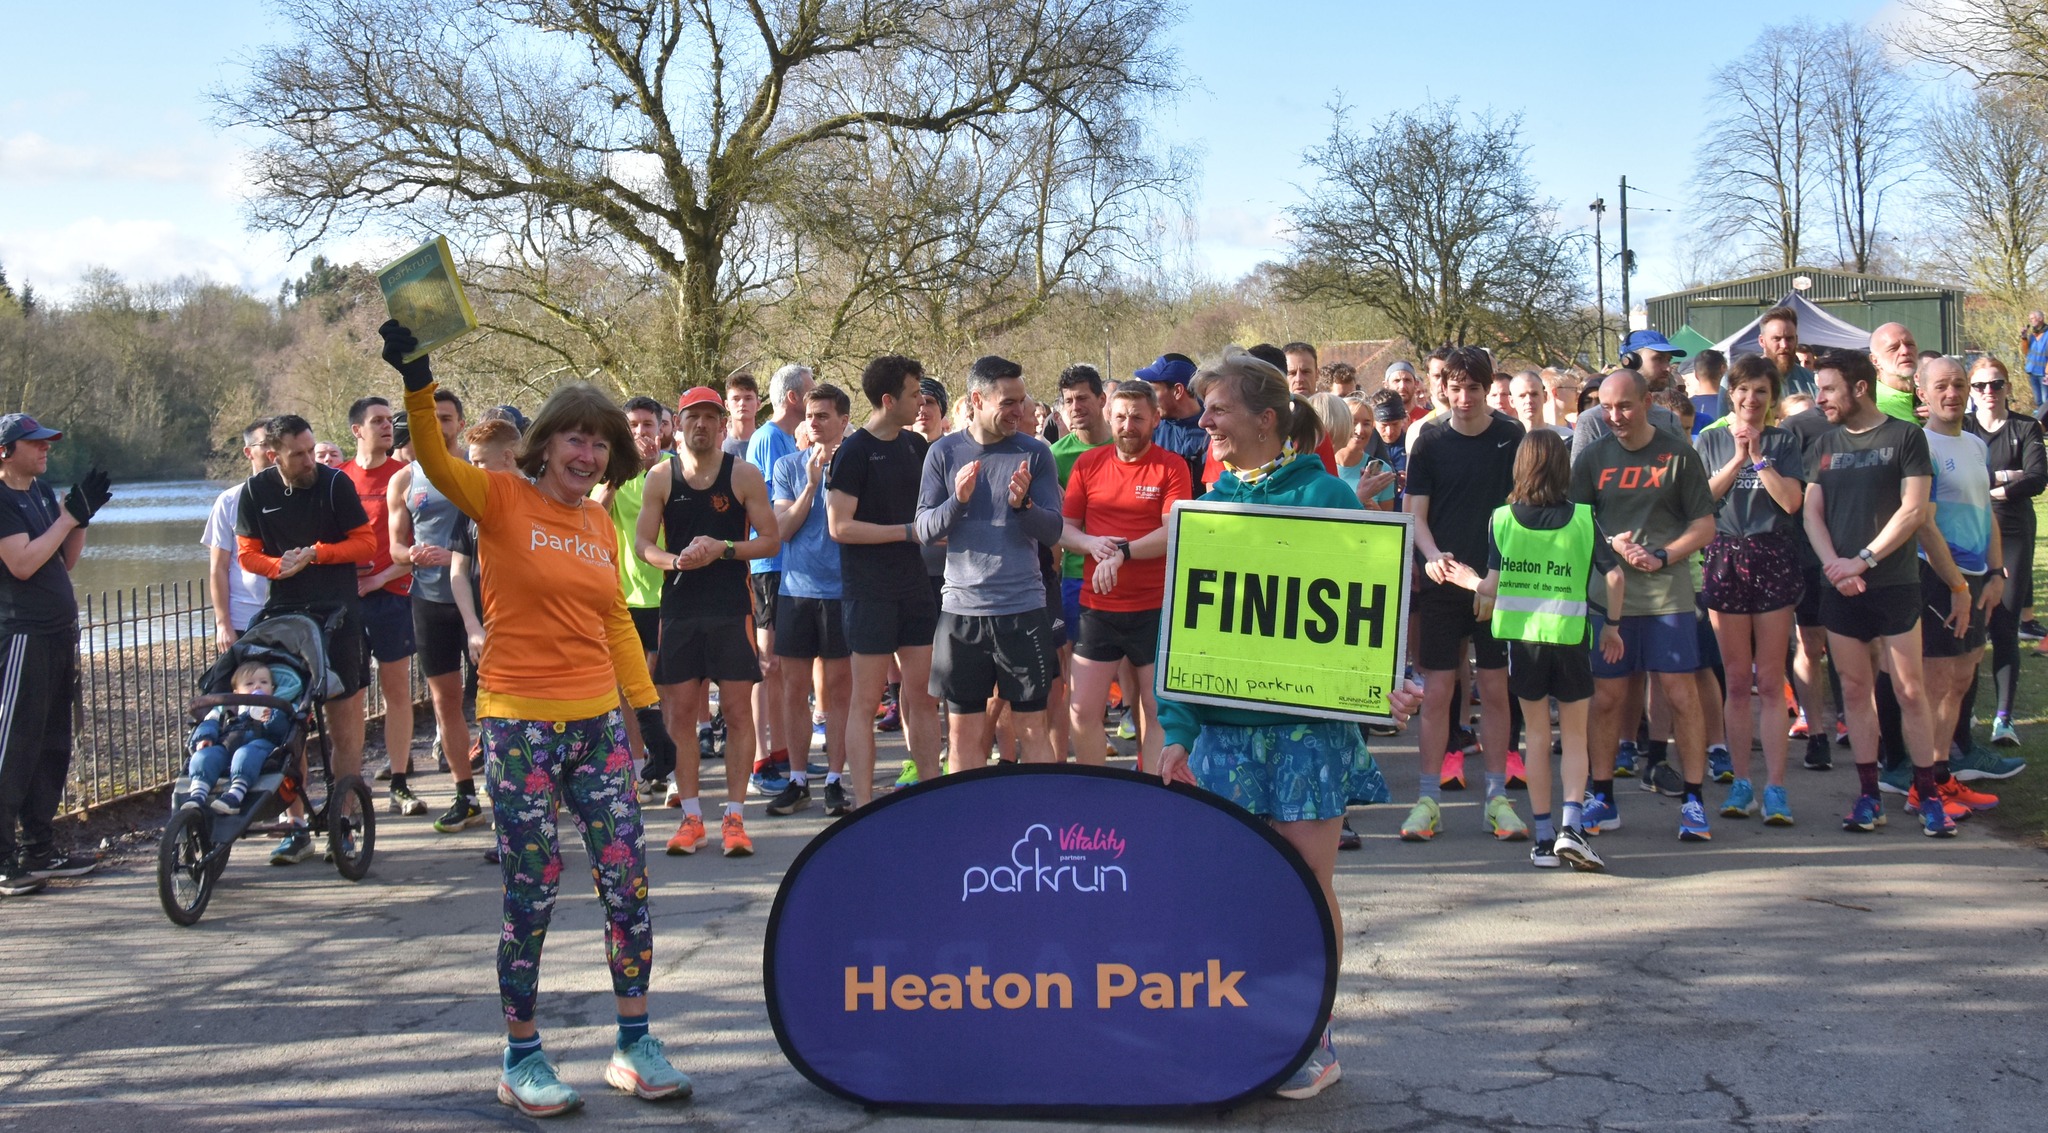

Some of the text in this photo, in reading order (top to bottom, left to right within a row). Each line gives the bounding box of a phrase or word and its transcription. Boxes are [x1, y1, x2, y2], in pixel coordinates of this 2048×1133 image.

[387, 253, 433, 287] parkrun
[1598, 466, 1669, 490] FOX
[530, 529, 611, 563] parkru
[1501, 557, 1572, 577] Heaton Park
[1499, 580, 1572, 594] parkrunner of the month
[1184, 568, 1387, 648] FINISH
[1168, 666, 1315, 695] HEATON parkrun
[1059, 823, 1126, 859] Vitality
[962, 846, 1127, 902] parkrun
[845, 959, 1249, 1011] Heaton Park
